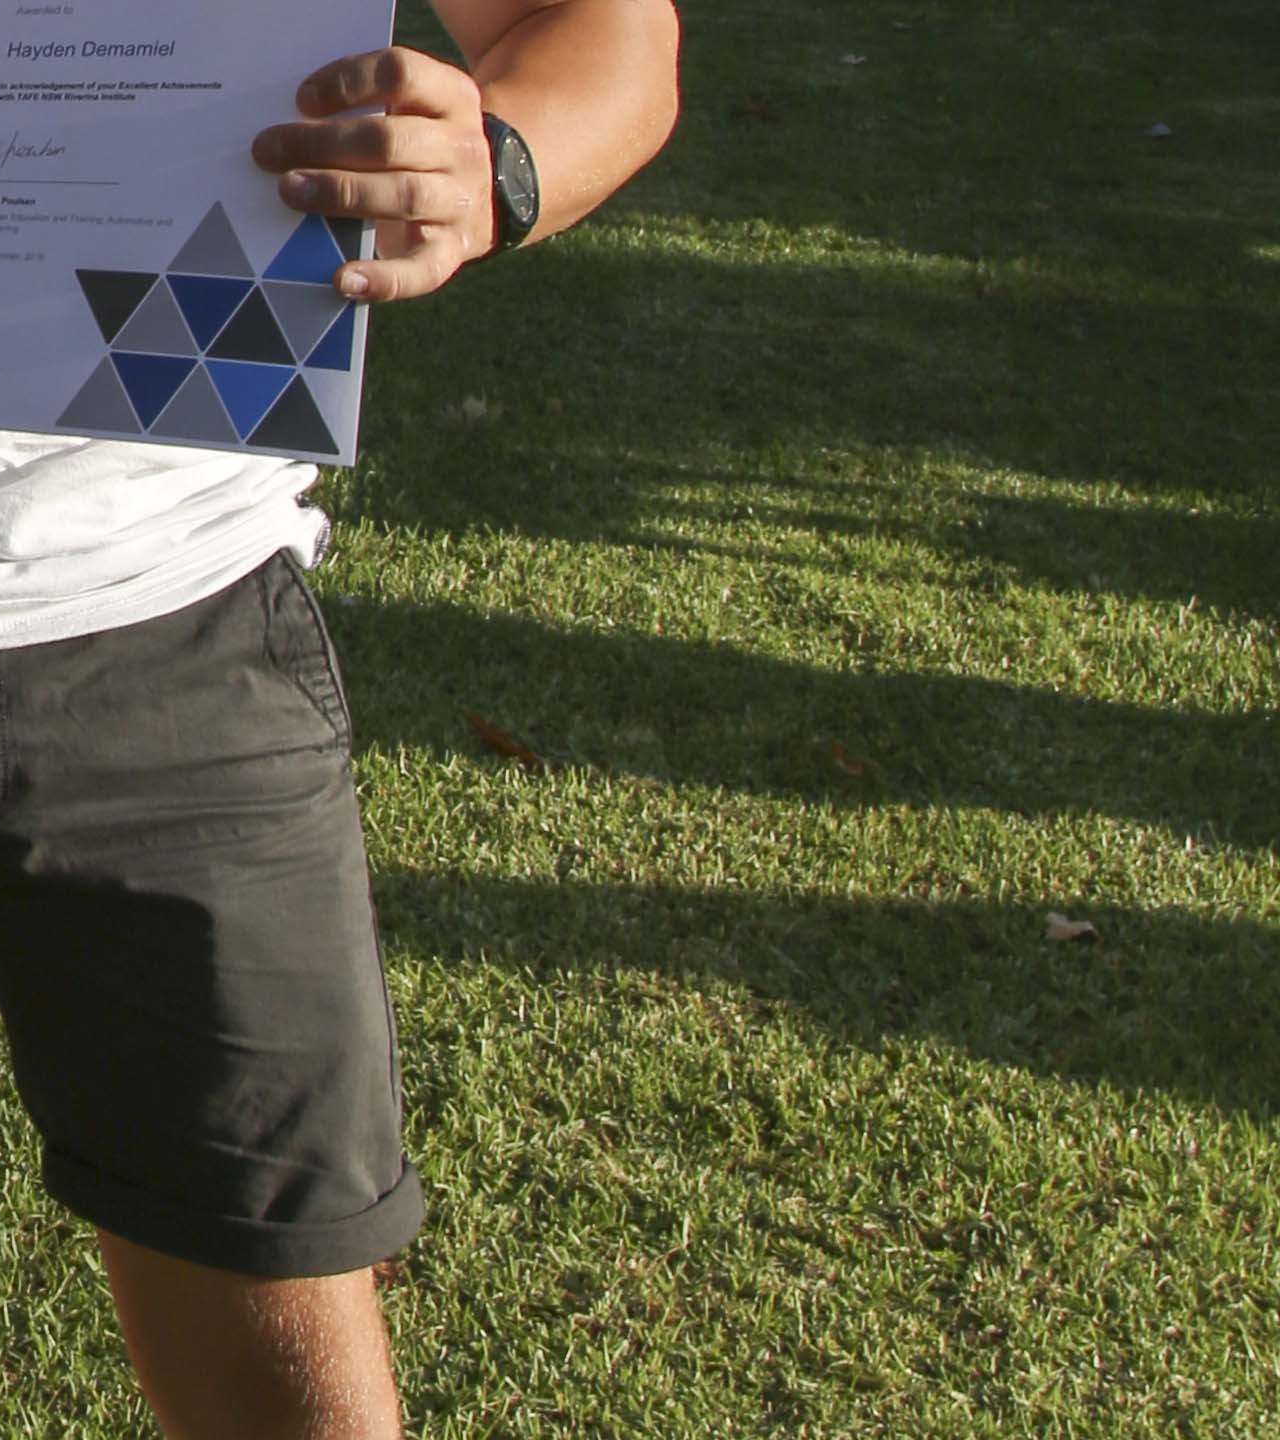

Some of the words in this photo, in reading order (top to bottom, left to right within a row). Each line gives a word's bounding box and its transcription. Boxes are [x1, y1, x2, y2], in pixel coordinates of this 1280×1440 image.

[15, 5, 61, 15] Awarded
[64, 5, 74, 15] to
[7, 41, 76, 61] Hayden
[81, 40, 175, 58] Demamiel
[9, 81, 85, 91] acknowledgement
[97, 82, 117, 92] your
[160, 81, 222, 90] Achievements
[17, 93, 39, 101] TAFE
[41, 93, 62, 101] NSW
[100, 93, 136, 101] Institute
